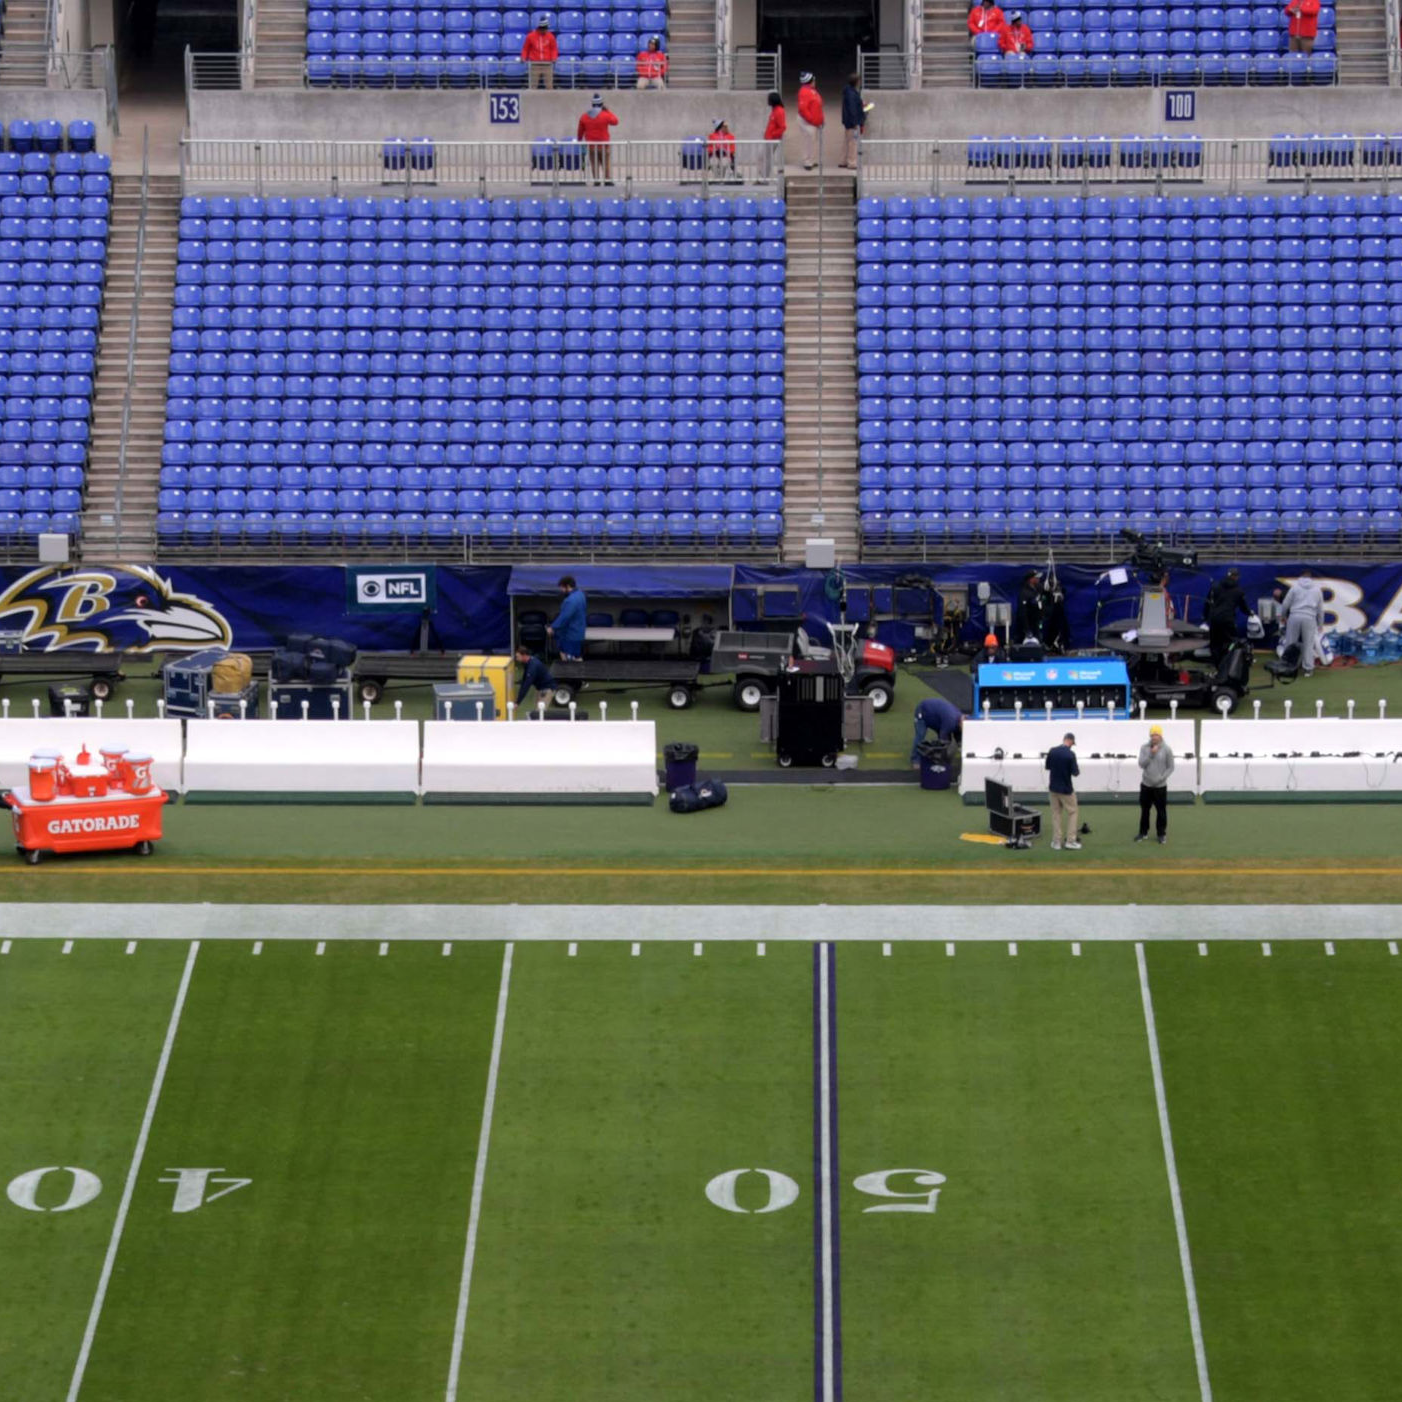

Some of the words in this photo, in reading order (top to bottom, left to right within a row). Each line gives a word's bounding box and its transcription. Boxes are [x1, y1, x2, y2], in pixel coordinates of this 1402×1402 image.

[491, 97, 519, 120] 153
[1169, 95, 1192, 118] 100
[388, 582, 419, 595] NFL
[47, 814, 140, 834] GATORADE
